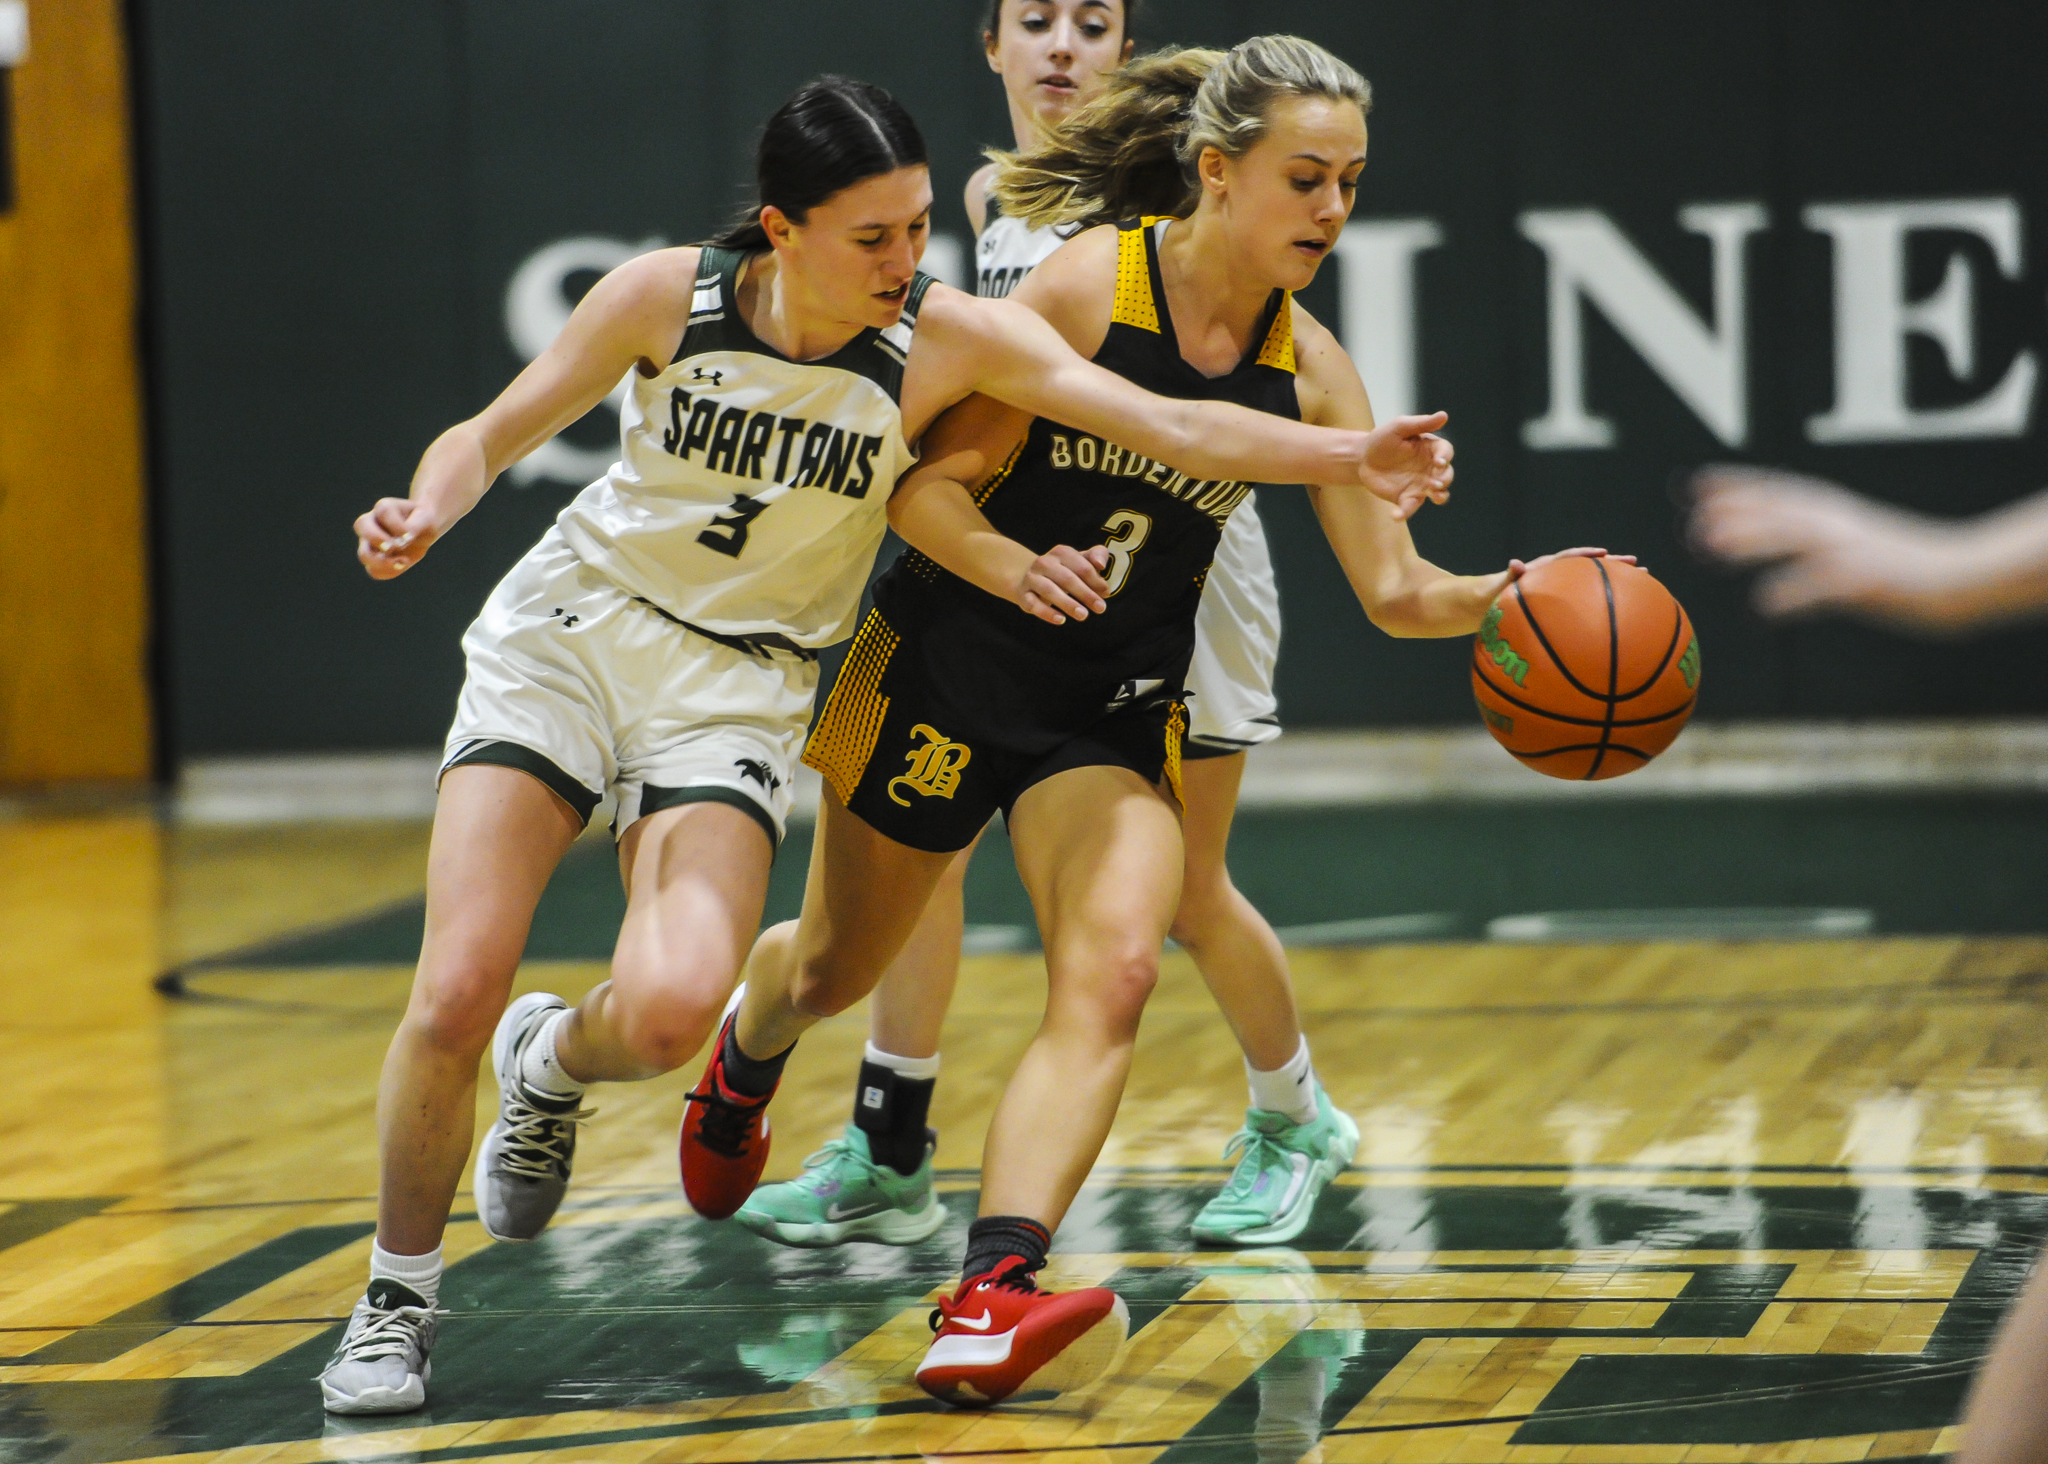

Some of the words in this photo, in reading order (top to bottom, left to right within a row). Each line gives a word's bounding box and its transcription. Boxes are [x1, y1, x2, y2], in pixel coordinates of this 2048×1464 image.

[663, 386, 884, 499] SPARTANS
[1051, 433, 1254, 531] BORDENOW
[695, 493, 773, 560] 3
[1101, 508, 1152, 598] 3
